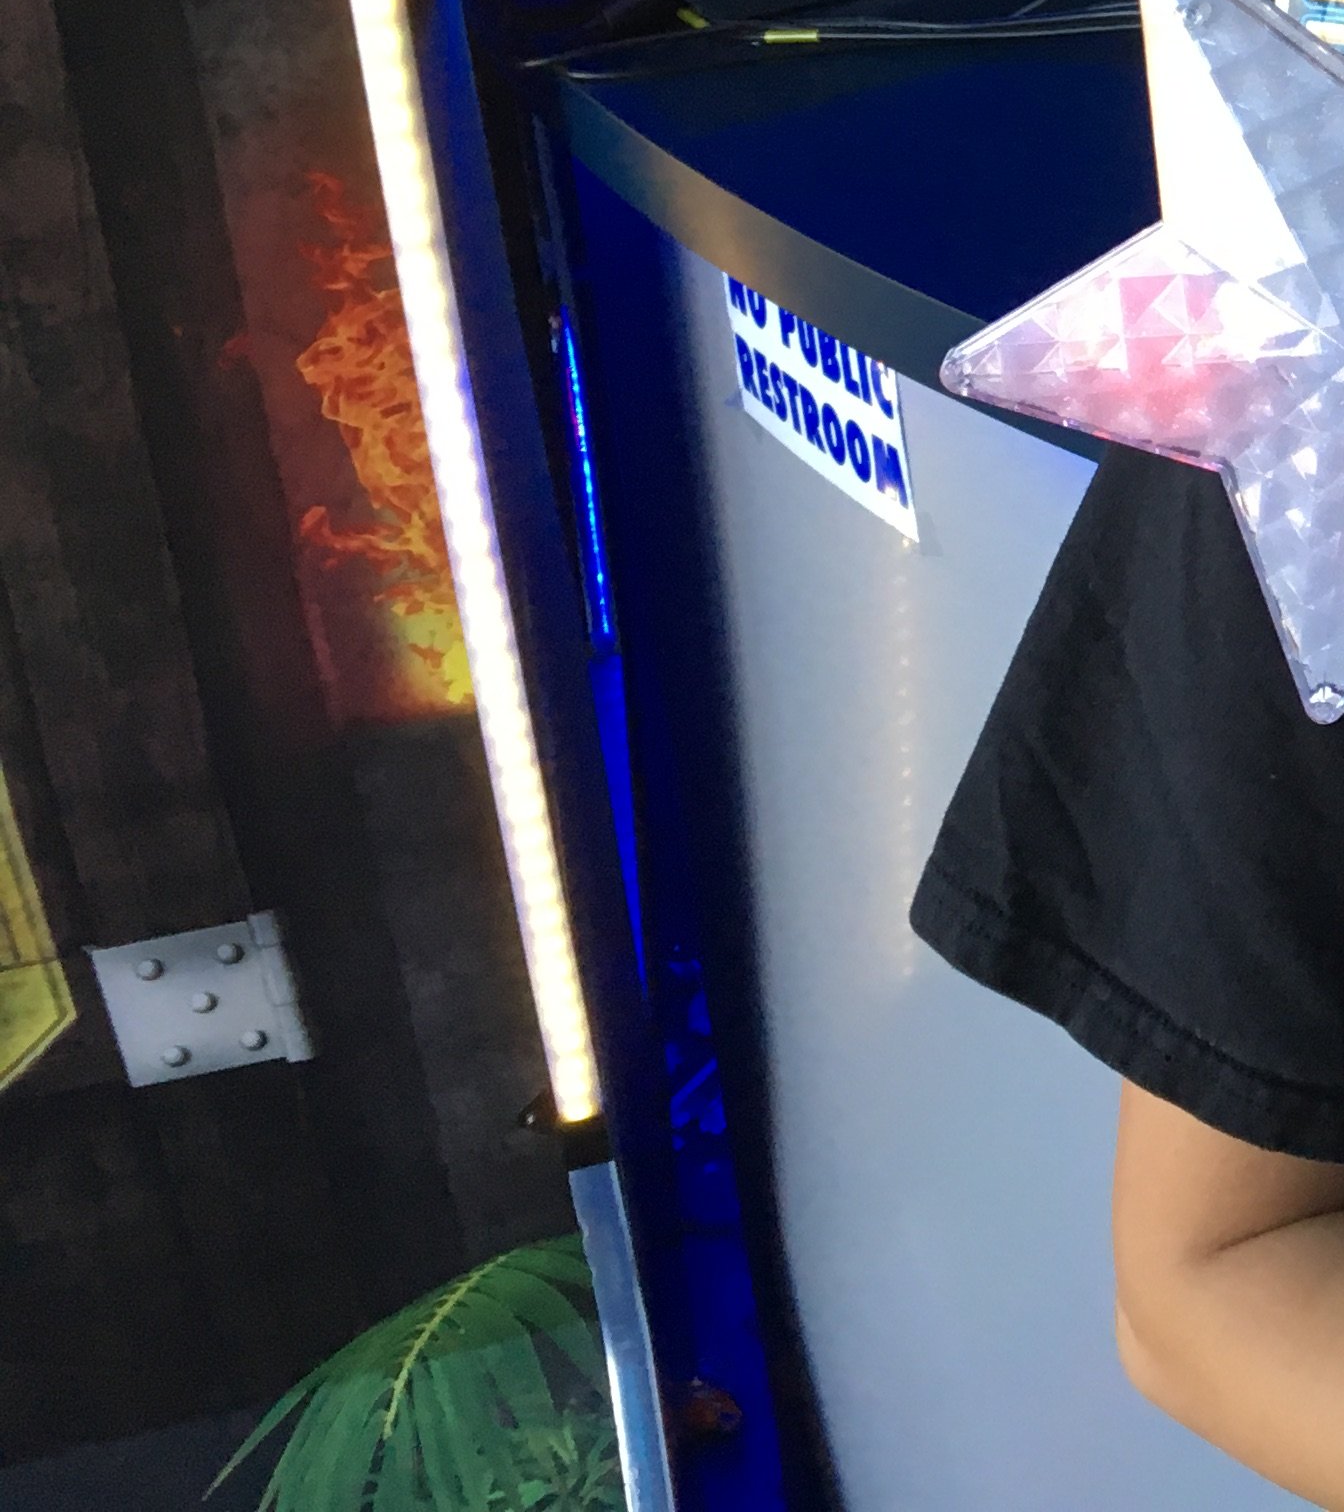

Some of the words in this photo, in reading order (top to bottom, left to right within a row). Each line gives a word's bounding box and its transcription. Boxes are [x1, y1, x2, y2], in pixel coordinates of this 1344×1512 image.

[728, 277, 767, 329] NO
[778, 307, 894, 420] PUBLIC
[735, 333, 909, 510] RESTROOM
